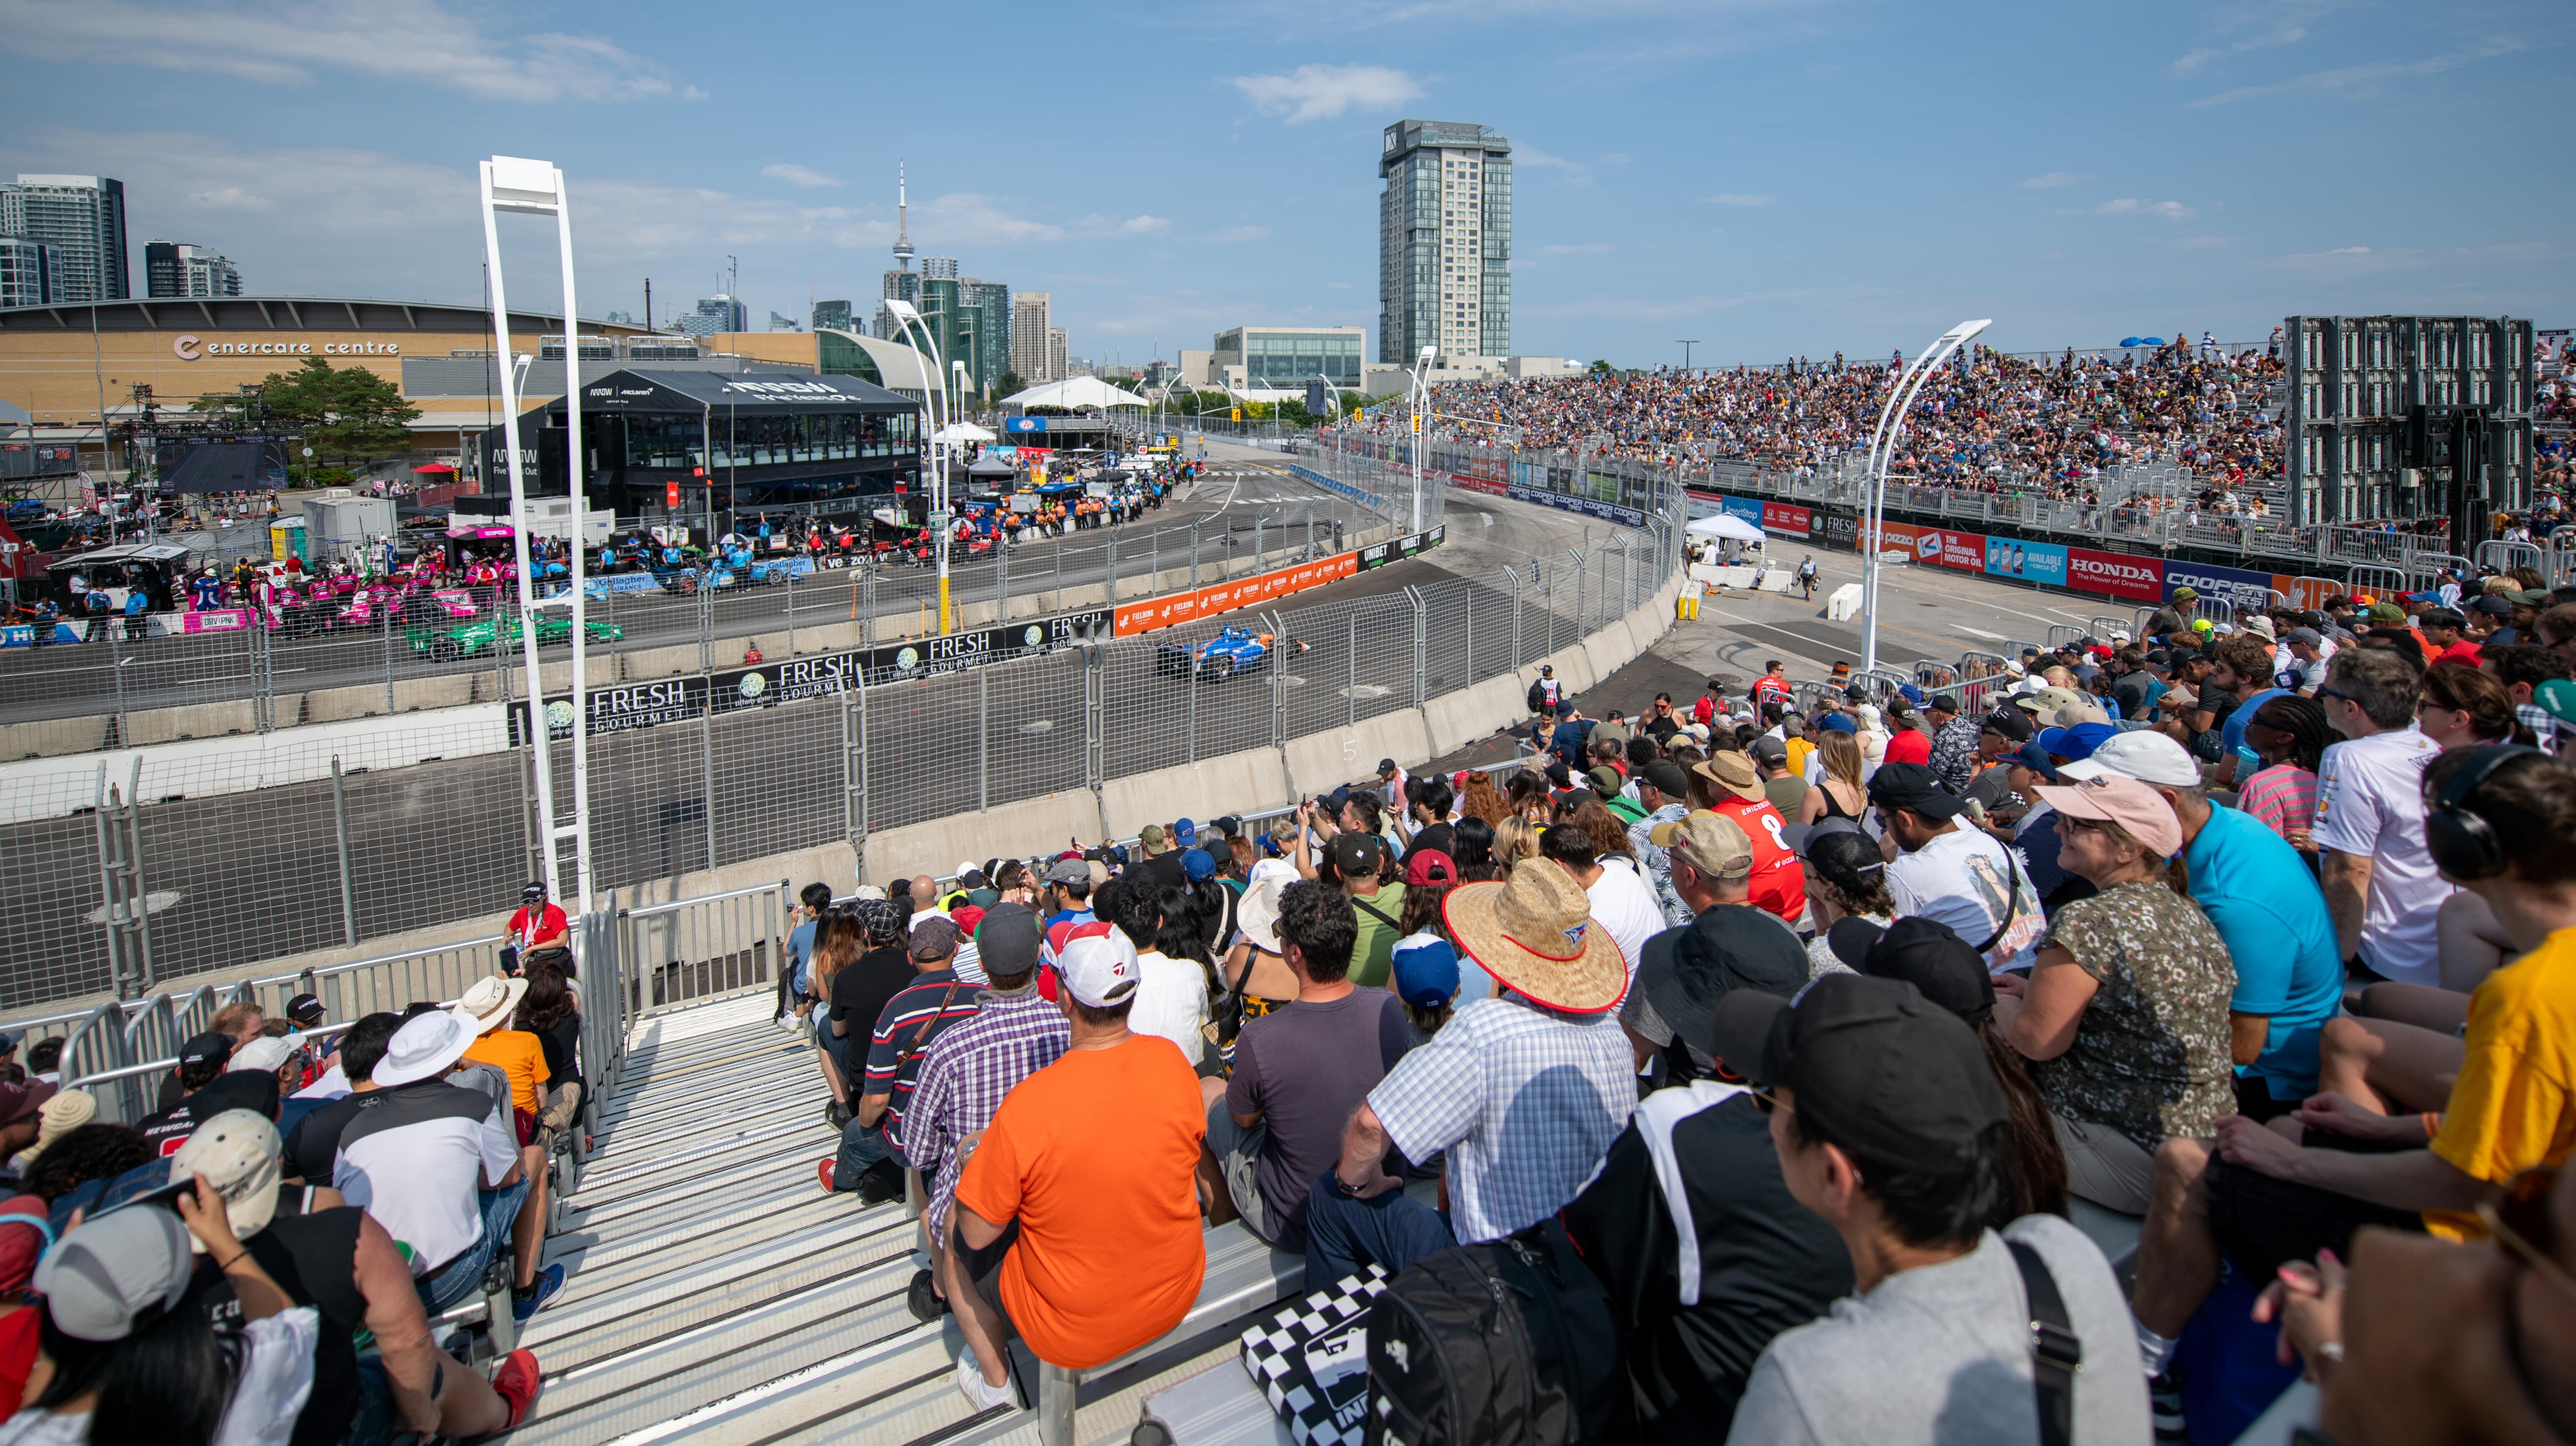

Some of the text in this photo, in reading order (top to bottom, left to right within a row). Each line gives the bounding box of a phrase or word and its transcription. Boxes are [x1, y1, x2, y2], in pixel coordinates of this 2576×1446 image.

[208, 342, 399, 354] enercare centre
[1508, 486, 1530, 495] COOPER
[1531, 490, 1555, 500] COOPER
[1556, 495, 1583, 506] COOPER
[1584, 501, 1613, 513] COOPER
[1614, 507, 1642, 520] COOPER
[1726, 506, 1757, 521] SmartStop
[1828, 517, 1857, 534] FRESH
[1400, 535, 1421, 551] UNIBET
[1827, 532, 1856, 543] GOURMET
[1885, 532, 1915, 546] pizza
[1945, 535, 1957, 545] THE
[1364, 544, 1388, 562] UNIBET
[1945, 546, 1977, 557] ORIGINAL
[769, 560, 806, 569] Gallagher
[1944, 553, 1982, 567] MOTOR OIL
[2028, 552, 2062, 566] AVAILABLE
[2070, 558, 2158, 583] HONDA
[599, 575, 646, 585] Gallagher
[1273, 577, 1286, 586] FIELDING
[2090, 575, 2110, 583] Power
[2121, 580, 2150, 590] Dreams
[2166, 572, 2266, 598] COOPER
[1243, 584, 1258, 594] FIELDING
[1211, 592, 1228, 603] FIELDING
[2212, 590, 2264, 606] TIRES
[1174, 600, 1194, 611] FIELDING
[221, 615, 234, 624] PNK
[1132, 609, 1154, 621] FIELDING
[930, 632, 989, 660] FRESH
[780, 655, 852, 686] FRESH
[931, 654, 989, 674] GOURMET
[893, 670, 908, 678] tiffany
[594, 681, 684, 715] FRESH
[735, 695, 771, 707] tiffany gate
[596, 709, 684, 732] GOURMET
[1343, 741, 1356, 761] 5
[1741, 801, 1771, 817] ERICSSON
[1761, 814, 1791, 851] 8
[298, 999, 318, 1009] COOPER
